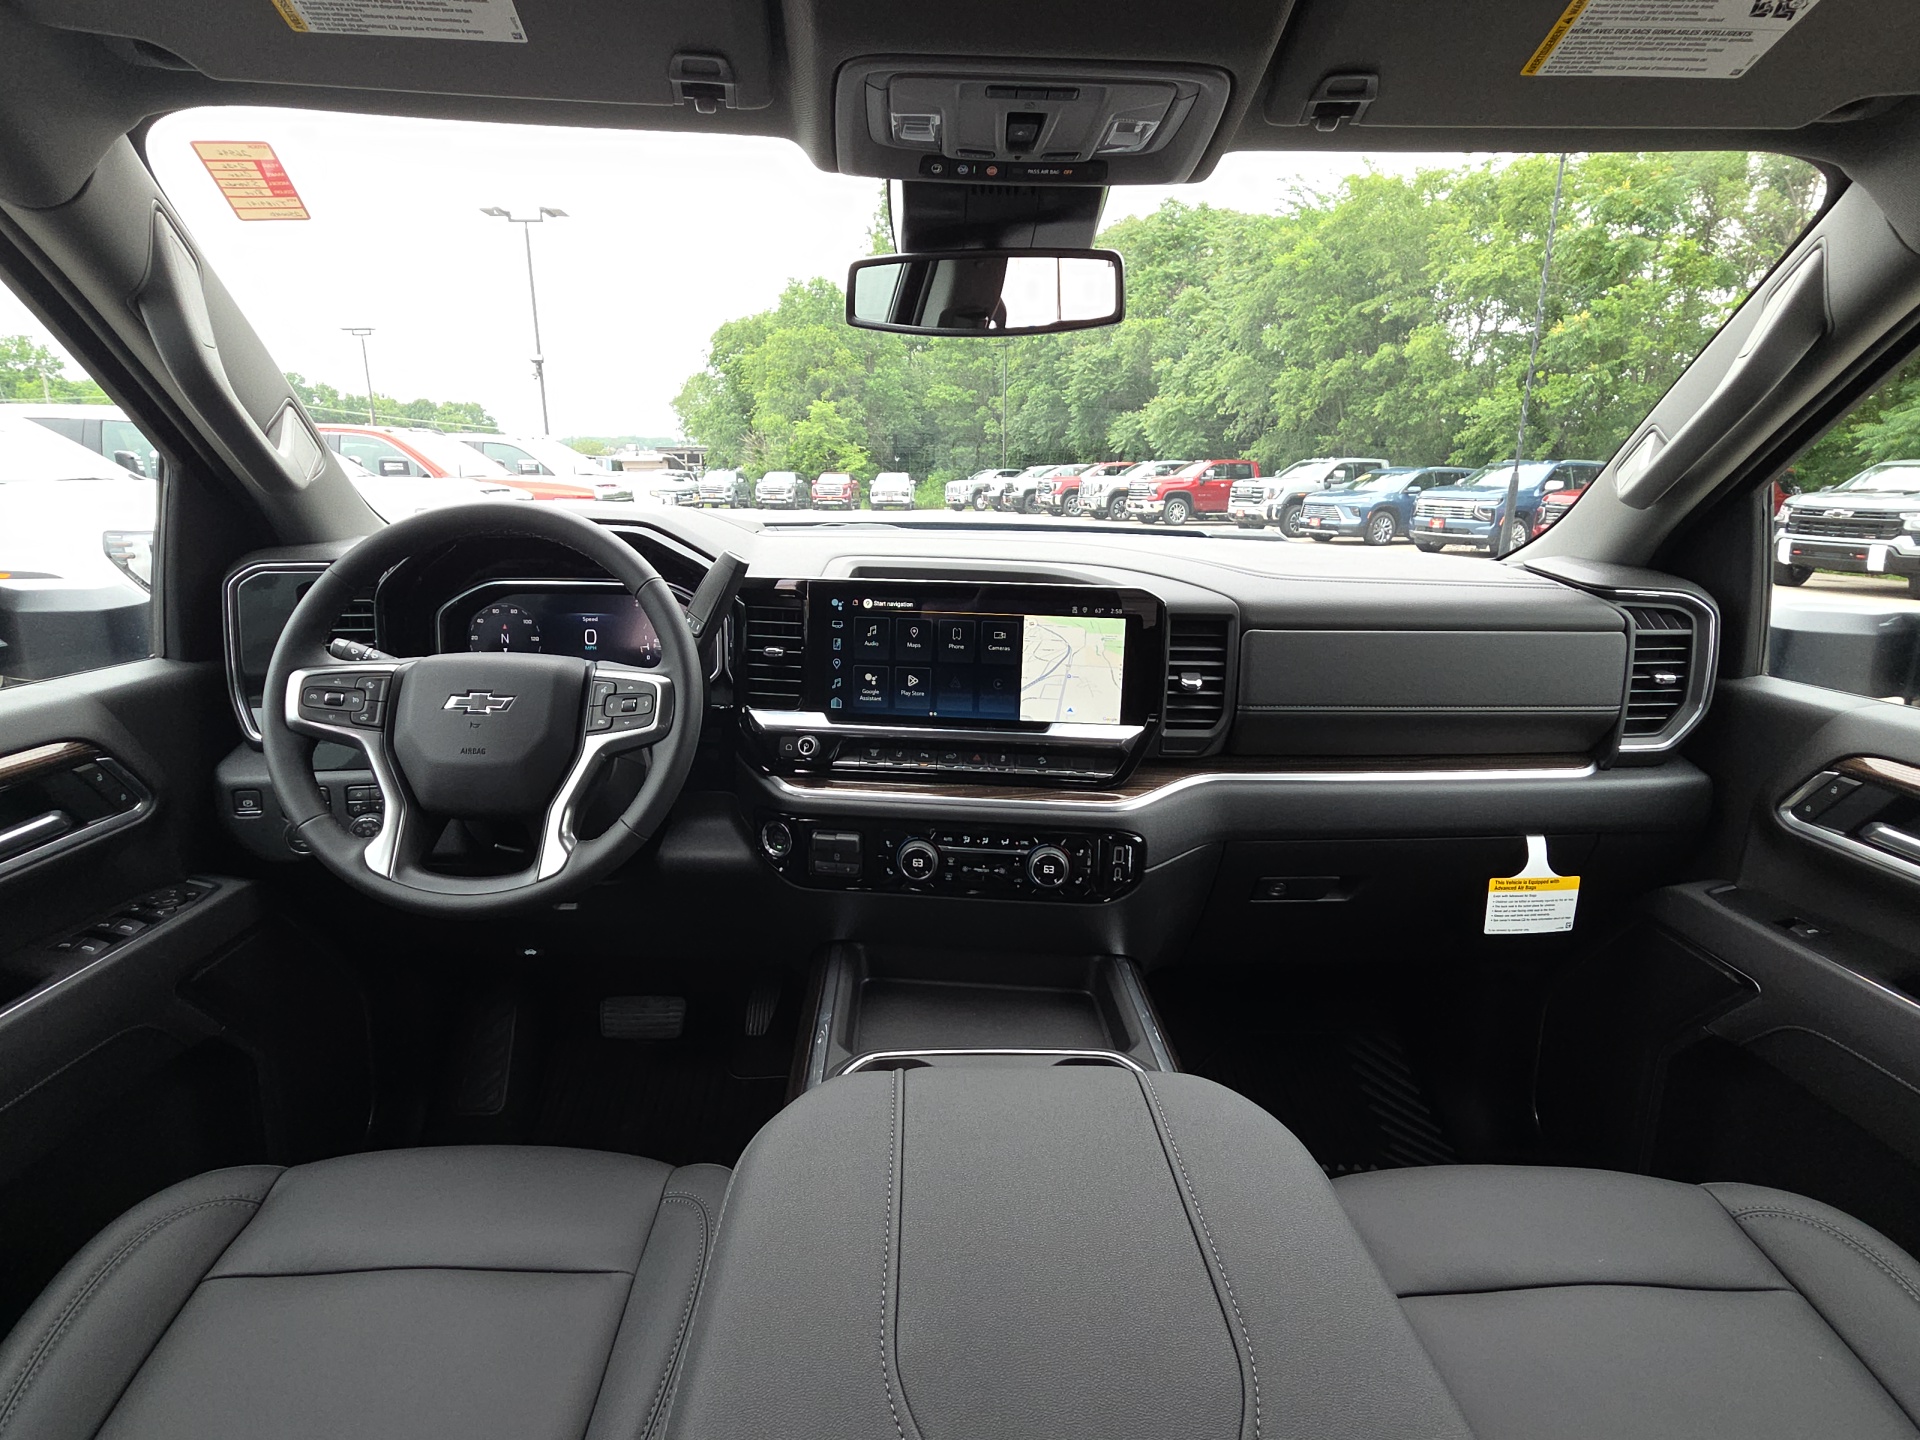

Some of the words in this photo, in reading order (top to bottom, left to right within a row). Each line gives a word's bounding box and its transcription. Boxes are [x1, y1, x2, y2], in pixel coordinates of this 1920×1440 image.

[1525, 25, 1567, 74] AVERTISSEMENT
[873, 600, 886, 608] Start
[887, 600, 913, 609] navigation
[500, 633, 510, 643] N
[584, 628, 597, 645] 0
[862, 688, 880, 696] Google
[859, 694, 882, 702] Assistant
[460, 747, 487, 755] AIRBAG
[912, 858, 924, 868] 63
[1043, 865, 1055, 874] 63
